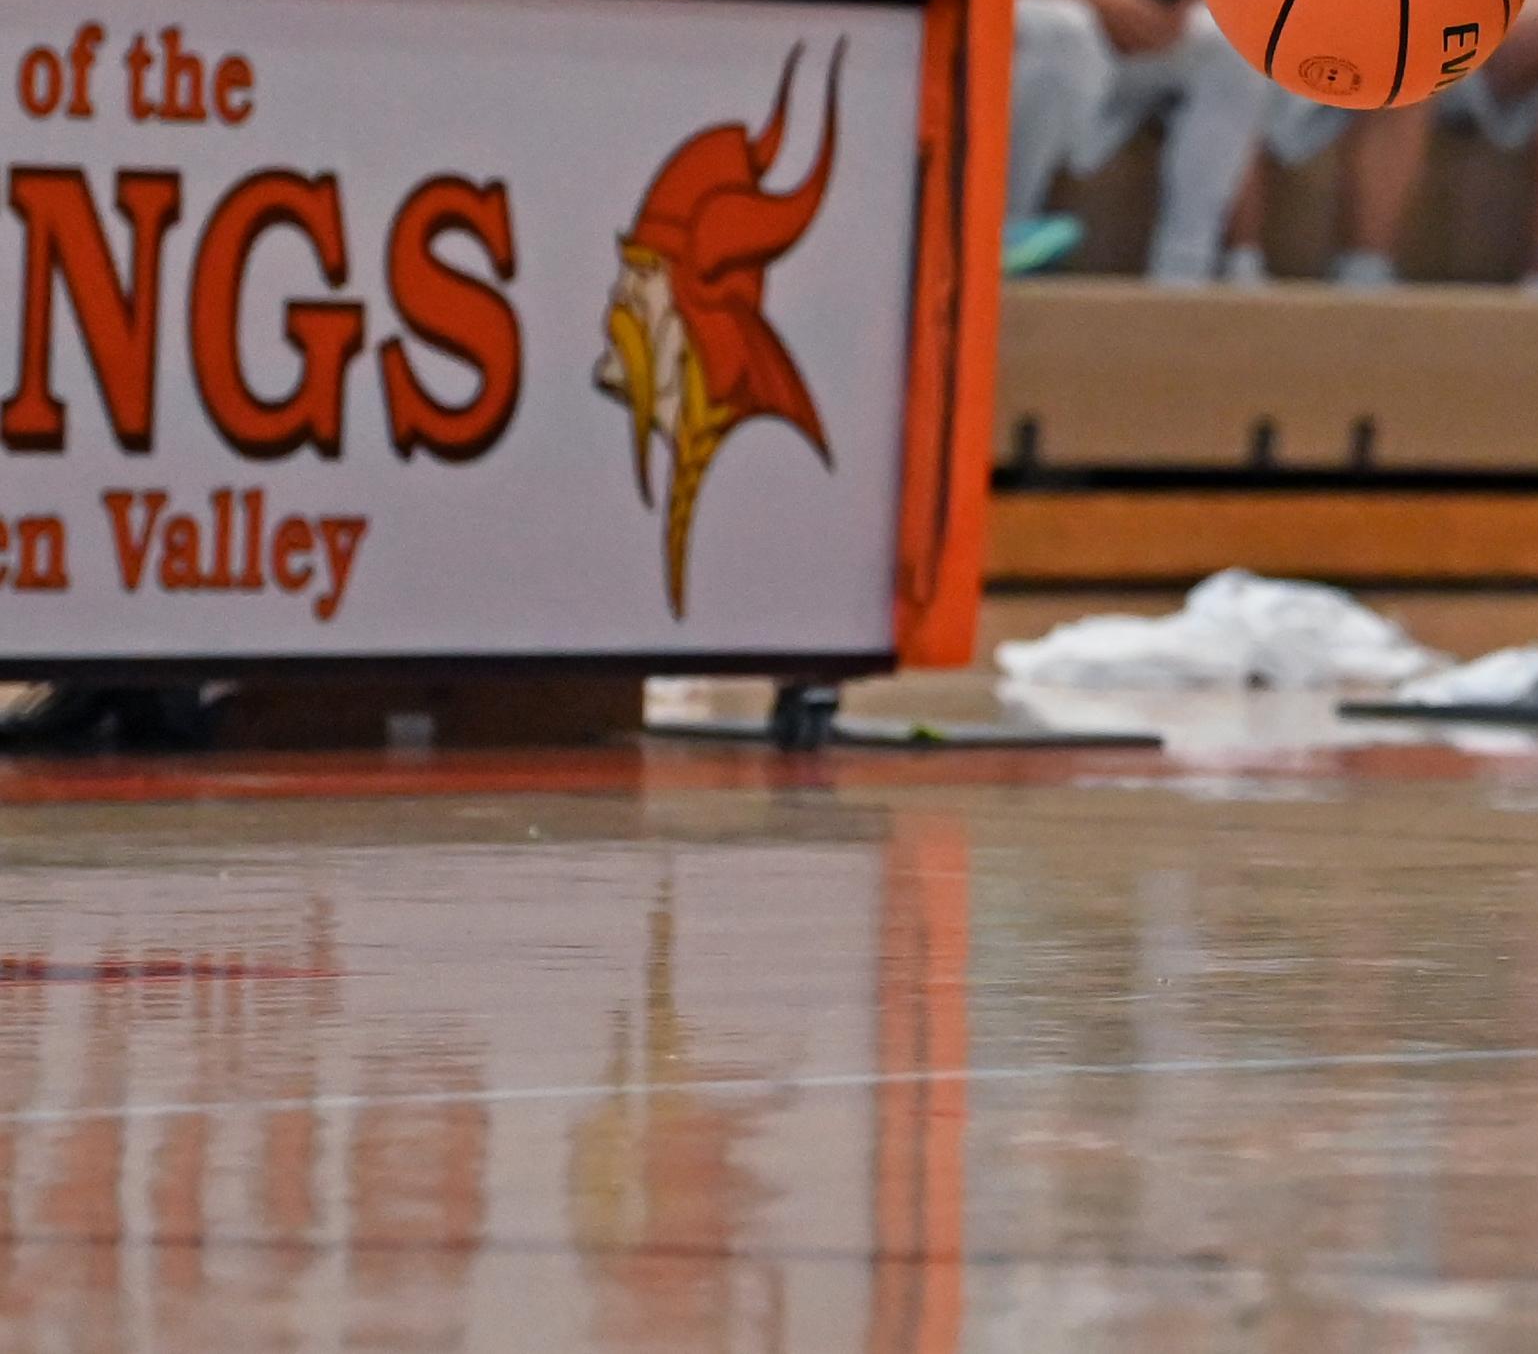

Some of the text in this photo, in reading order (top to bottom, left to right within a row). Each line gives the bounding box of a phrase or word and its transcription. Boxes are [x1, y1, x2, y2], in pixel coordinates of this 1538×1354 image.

[18, 21, 256, 127] of the
[0, 486, 369, 624] n Valley
